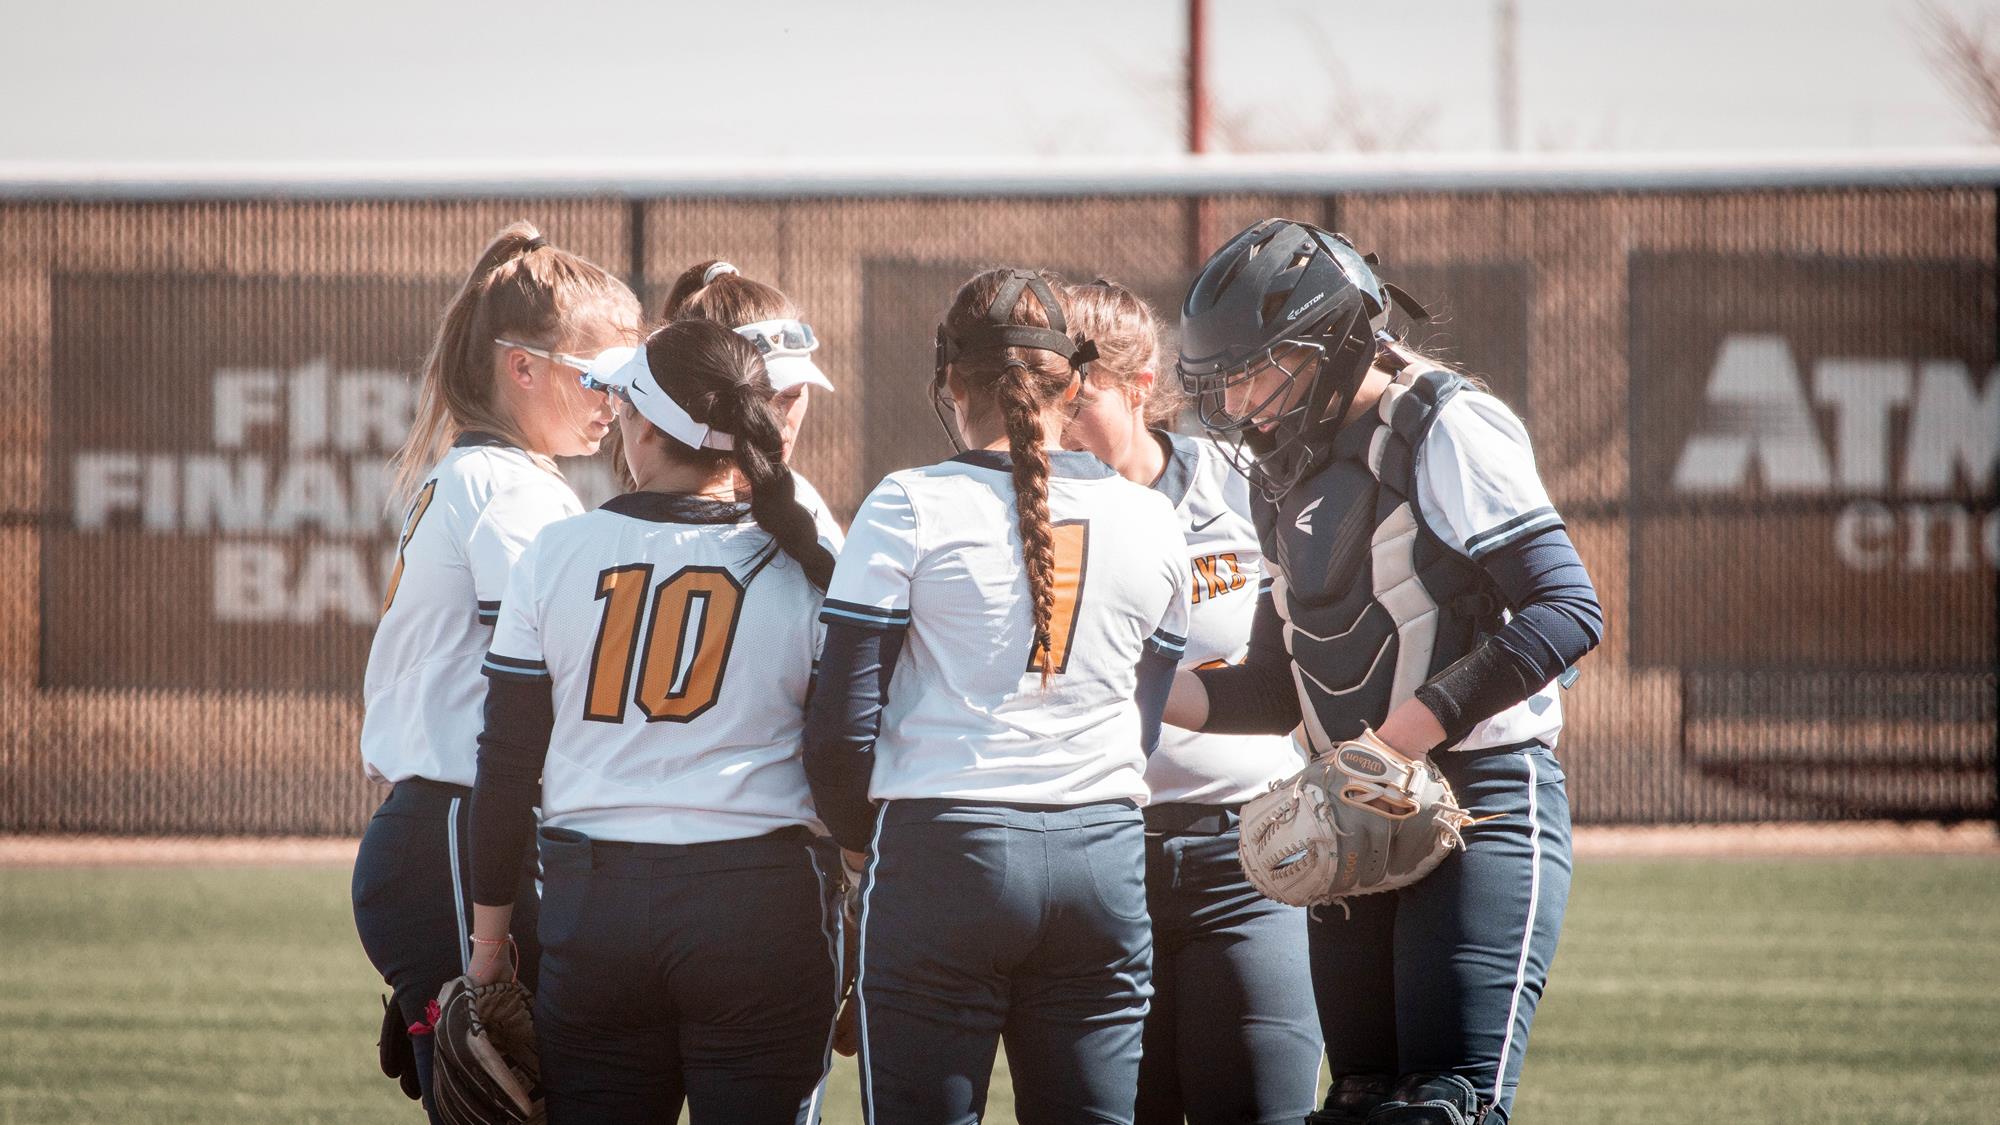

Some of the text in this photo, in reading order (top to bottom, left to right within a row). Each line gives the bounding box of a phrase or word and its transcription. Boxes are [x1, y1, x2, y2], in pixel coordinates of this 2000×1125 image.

[1294, 292, 1325, 317] EASTON
[212, 358, 425, 451] FIR
[1834, 501, 1998, 572] en
[583, 562, 745, 724] 10
